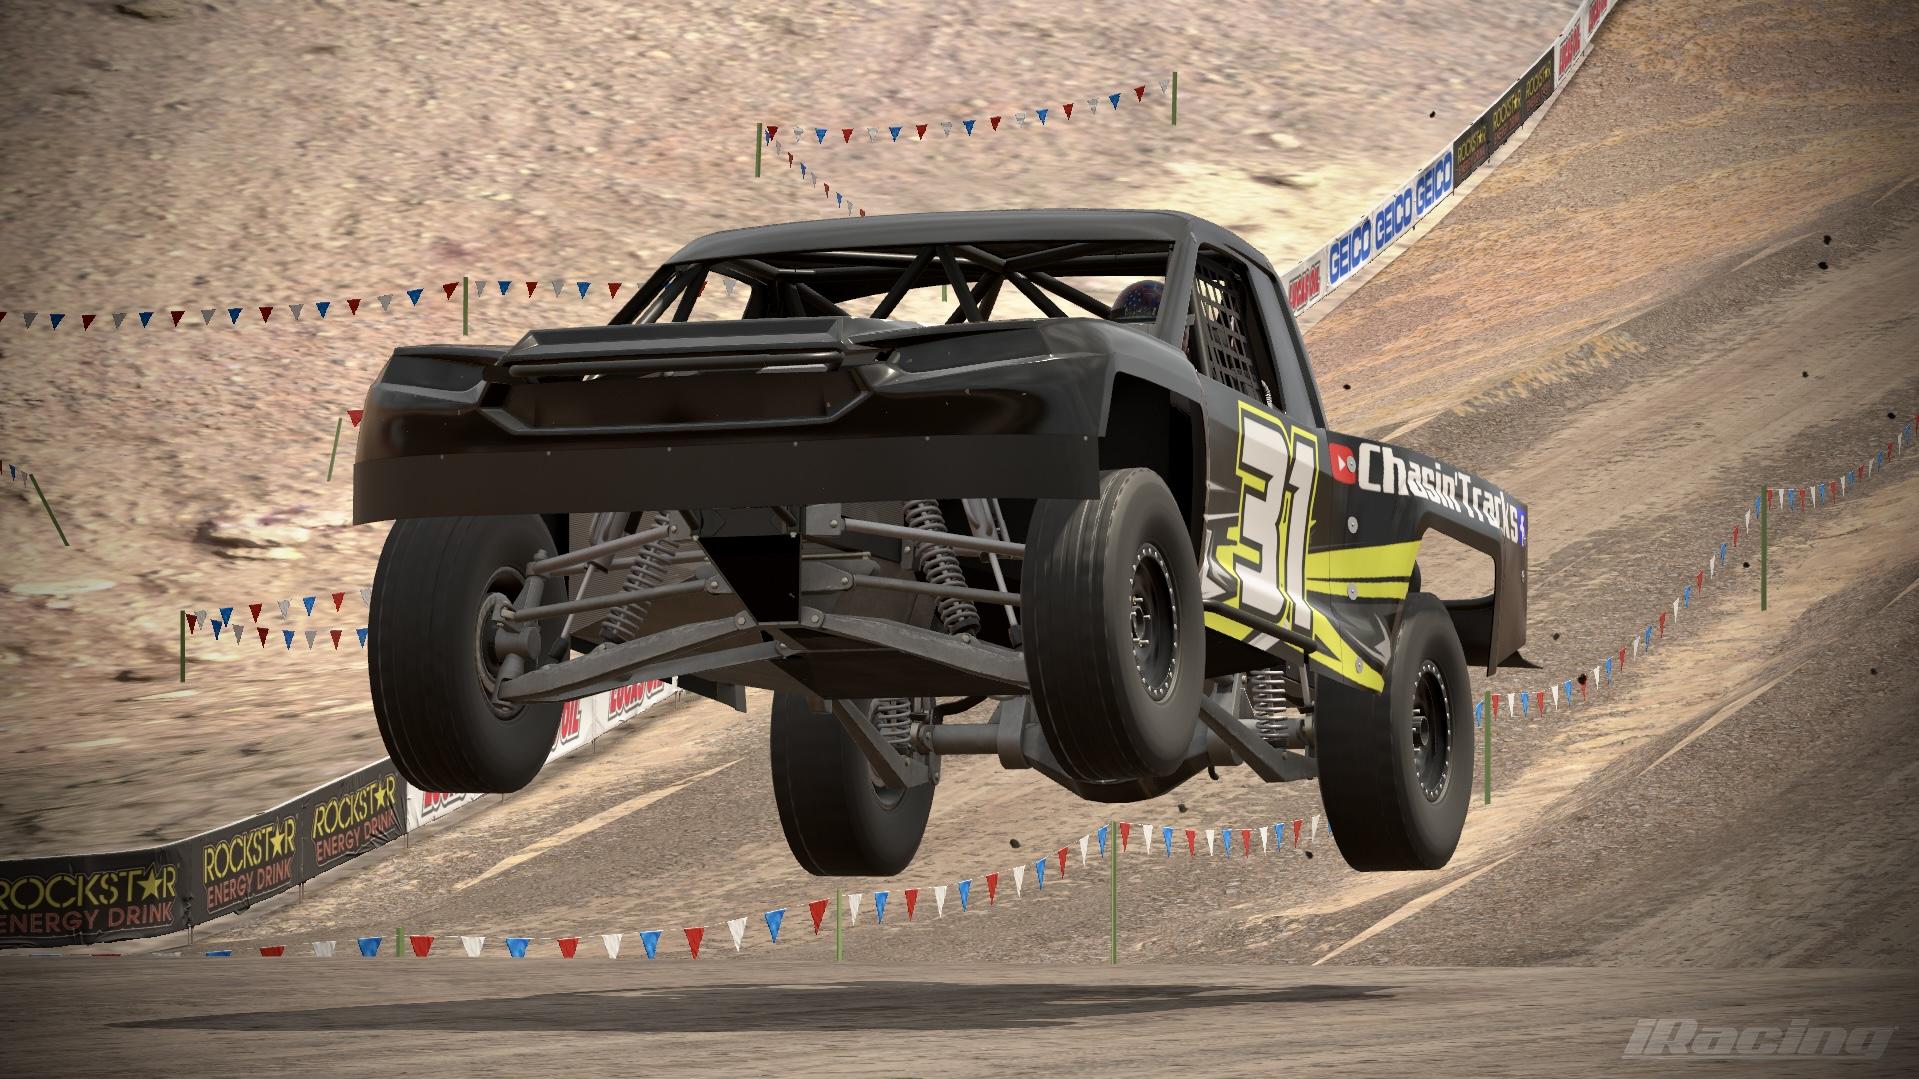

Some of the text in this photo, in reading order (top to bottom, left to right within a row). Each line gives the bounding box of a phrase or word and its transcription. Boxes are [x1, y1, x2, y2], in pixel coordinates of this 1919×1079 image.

[1416, 151, 1453, 216] GEICO
[1329, 217, 1371, 284] GEICO
[1375, 188, 1412, 250] GEICO
[1234, 413, 1317, 631] 31
[313, 774, 396, 839] ROCKSTAR
[316, 809, 396, 862] ENERGY DRINK
[204, 818, 296, 884] ROCKSTAR
[207, 857, 293, 908] ENERGY DRINK
[107, 901, 174, 929] DRINK
